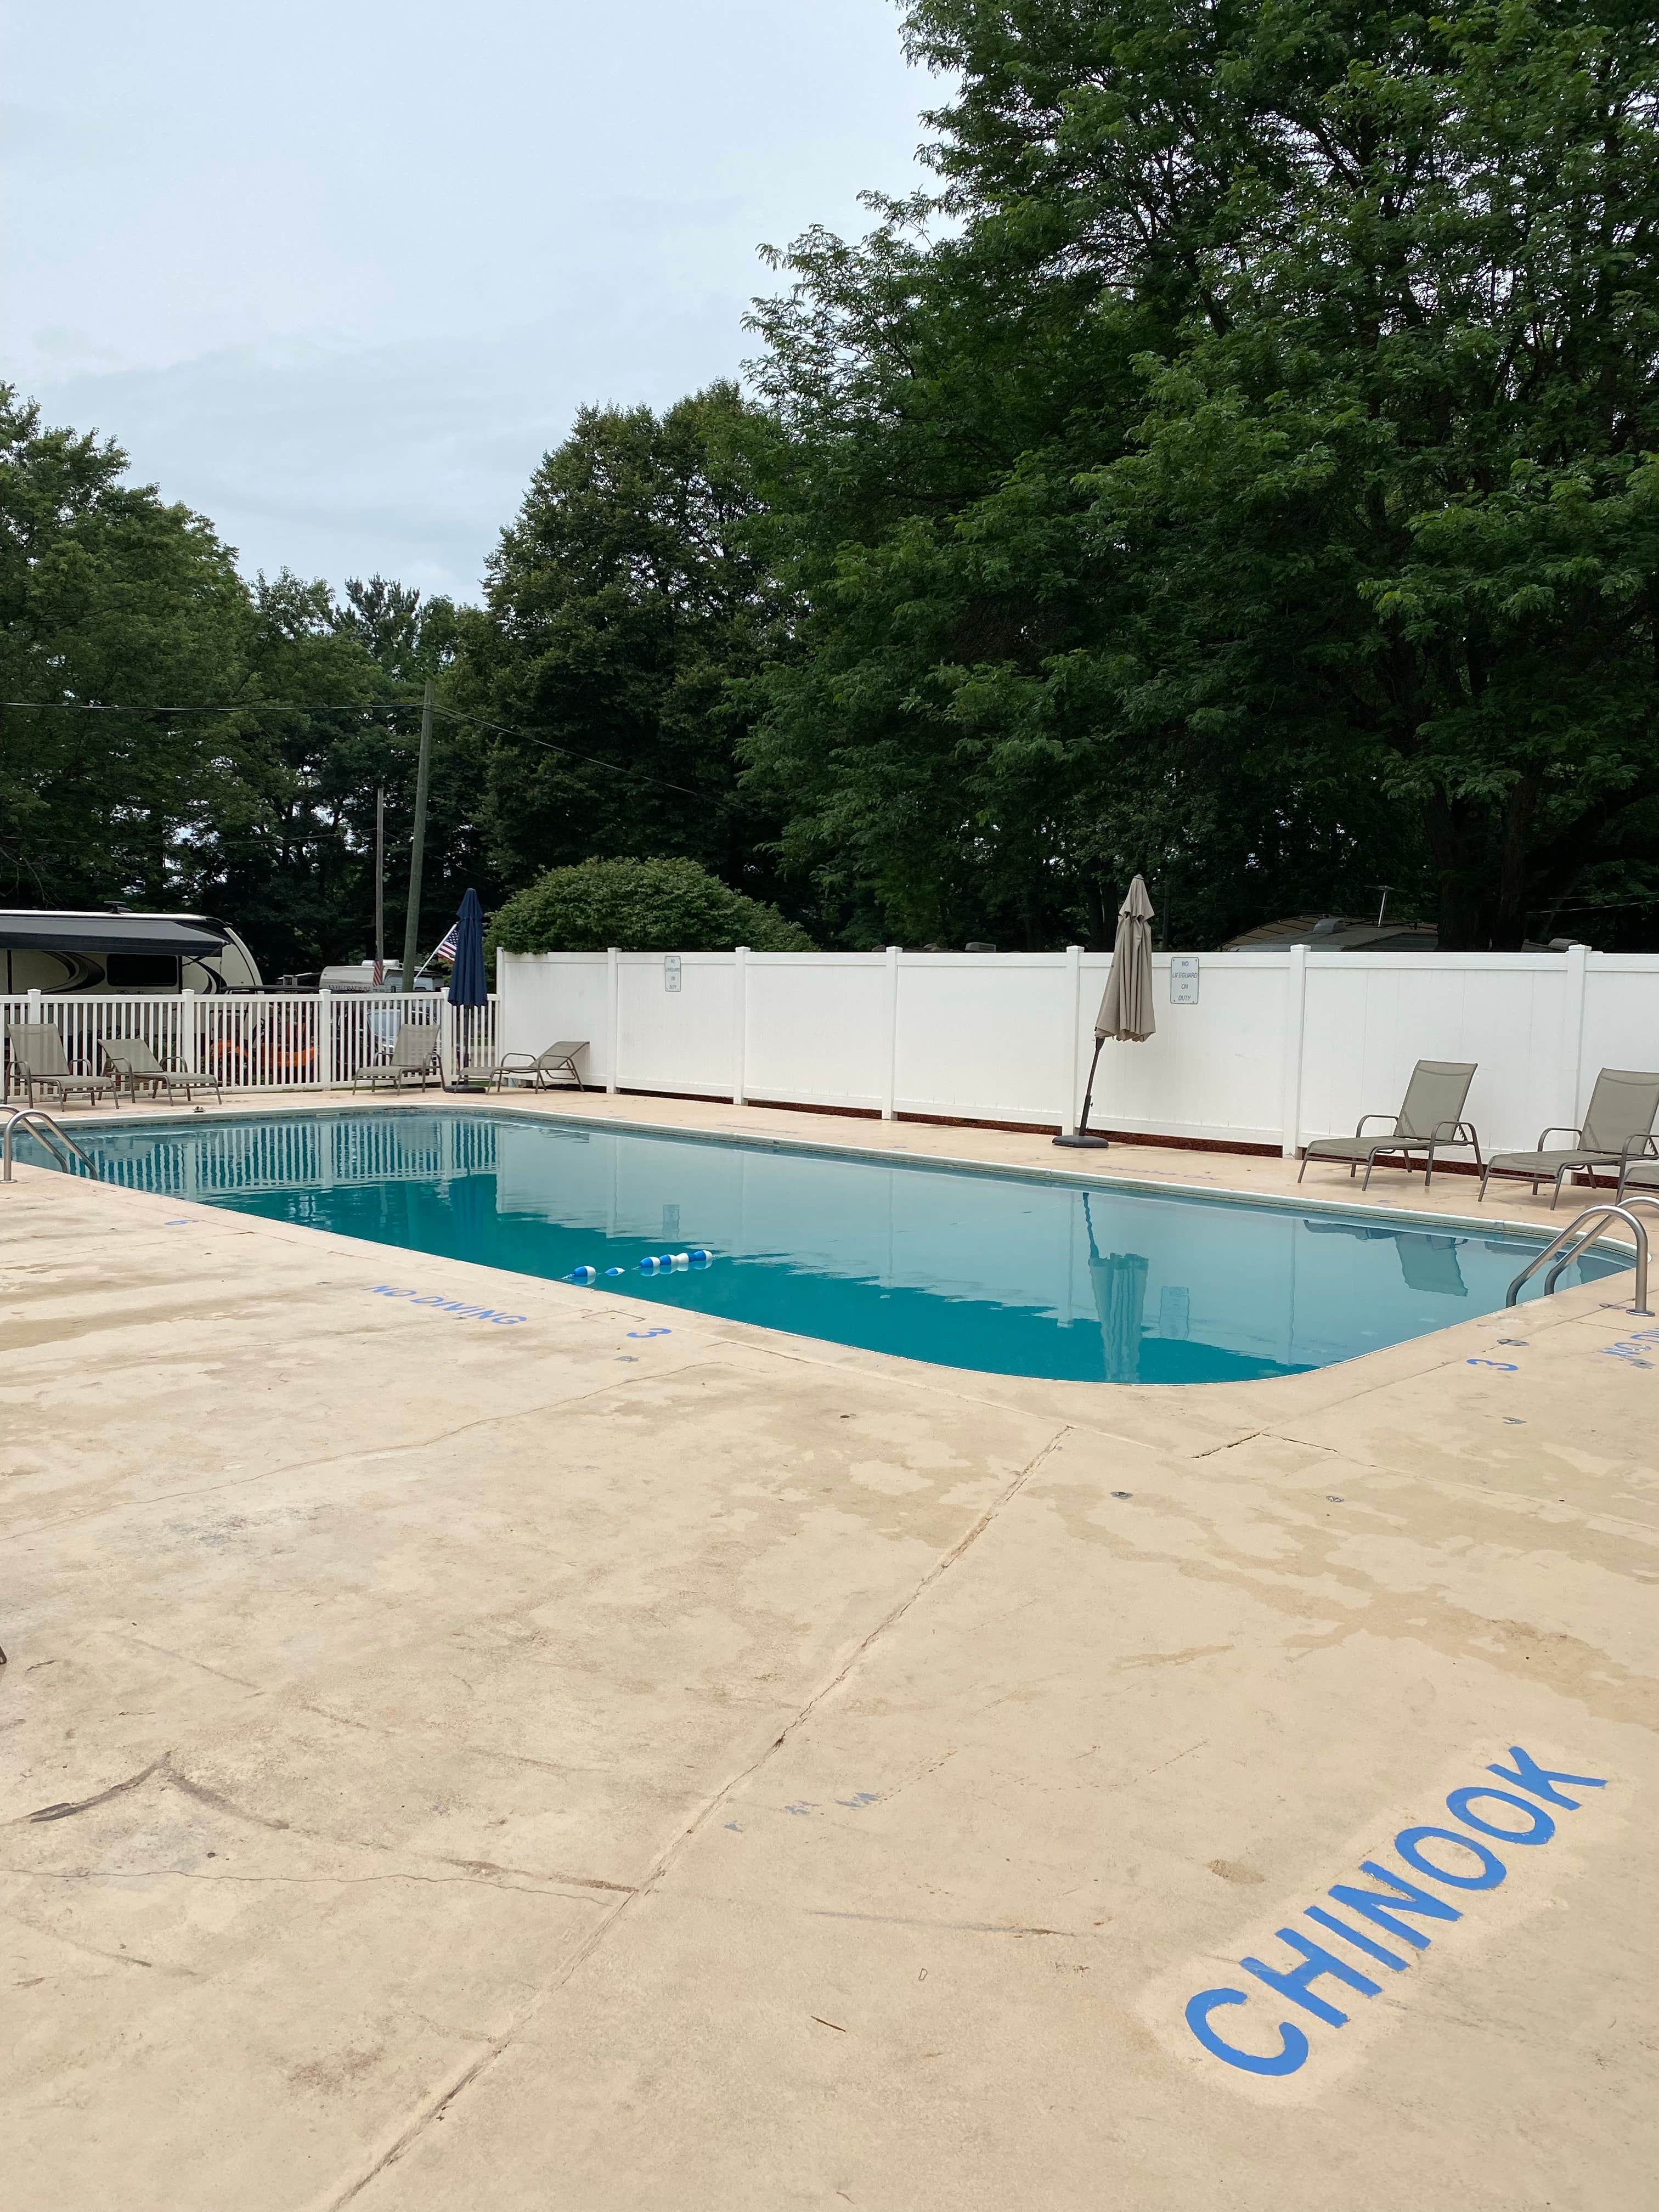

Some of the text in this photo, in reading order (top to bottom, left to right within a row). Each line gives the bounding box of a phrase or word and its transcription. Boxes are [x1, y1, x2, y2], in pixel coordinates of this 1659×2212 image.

[363, 1285, 527, 1324] NO DIVING
[627, 1328, 672, 1338] 3
[1466, 1358, 1519, 1371] 3
[1185, 1746, 1609, 2076] CHINOOK
